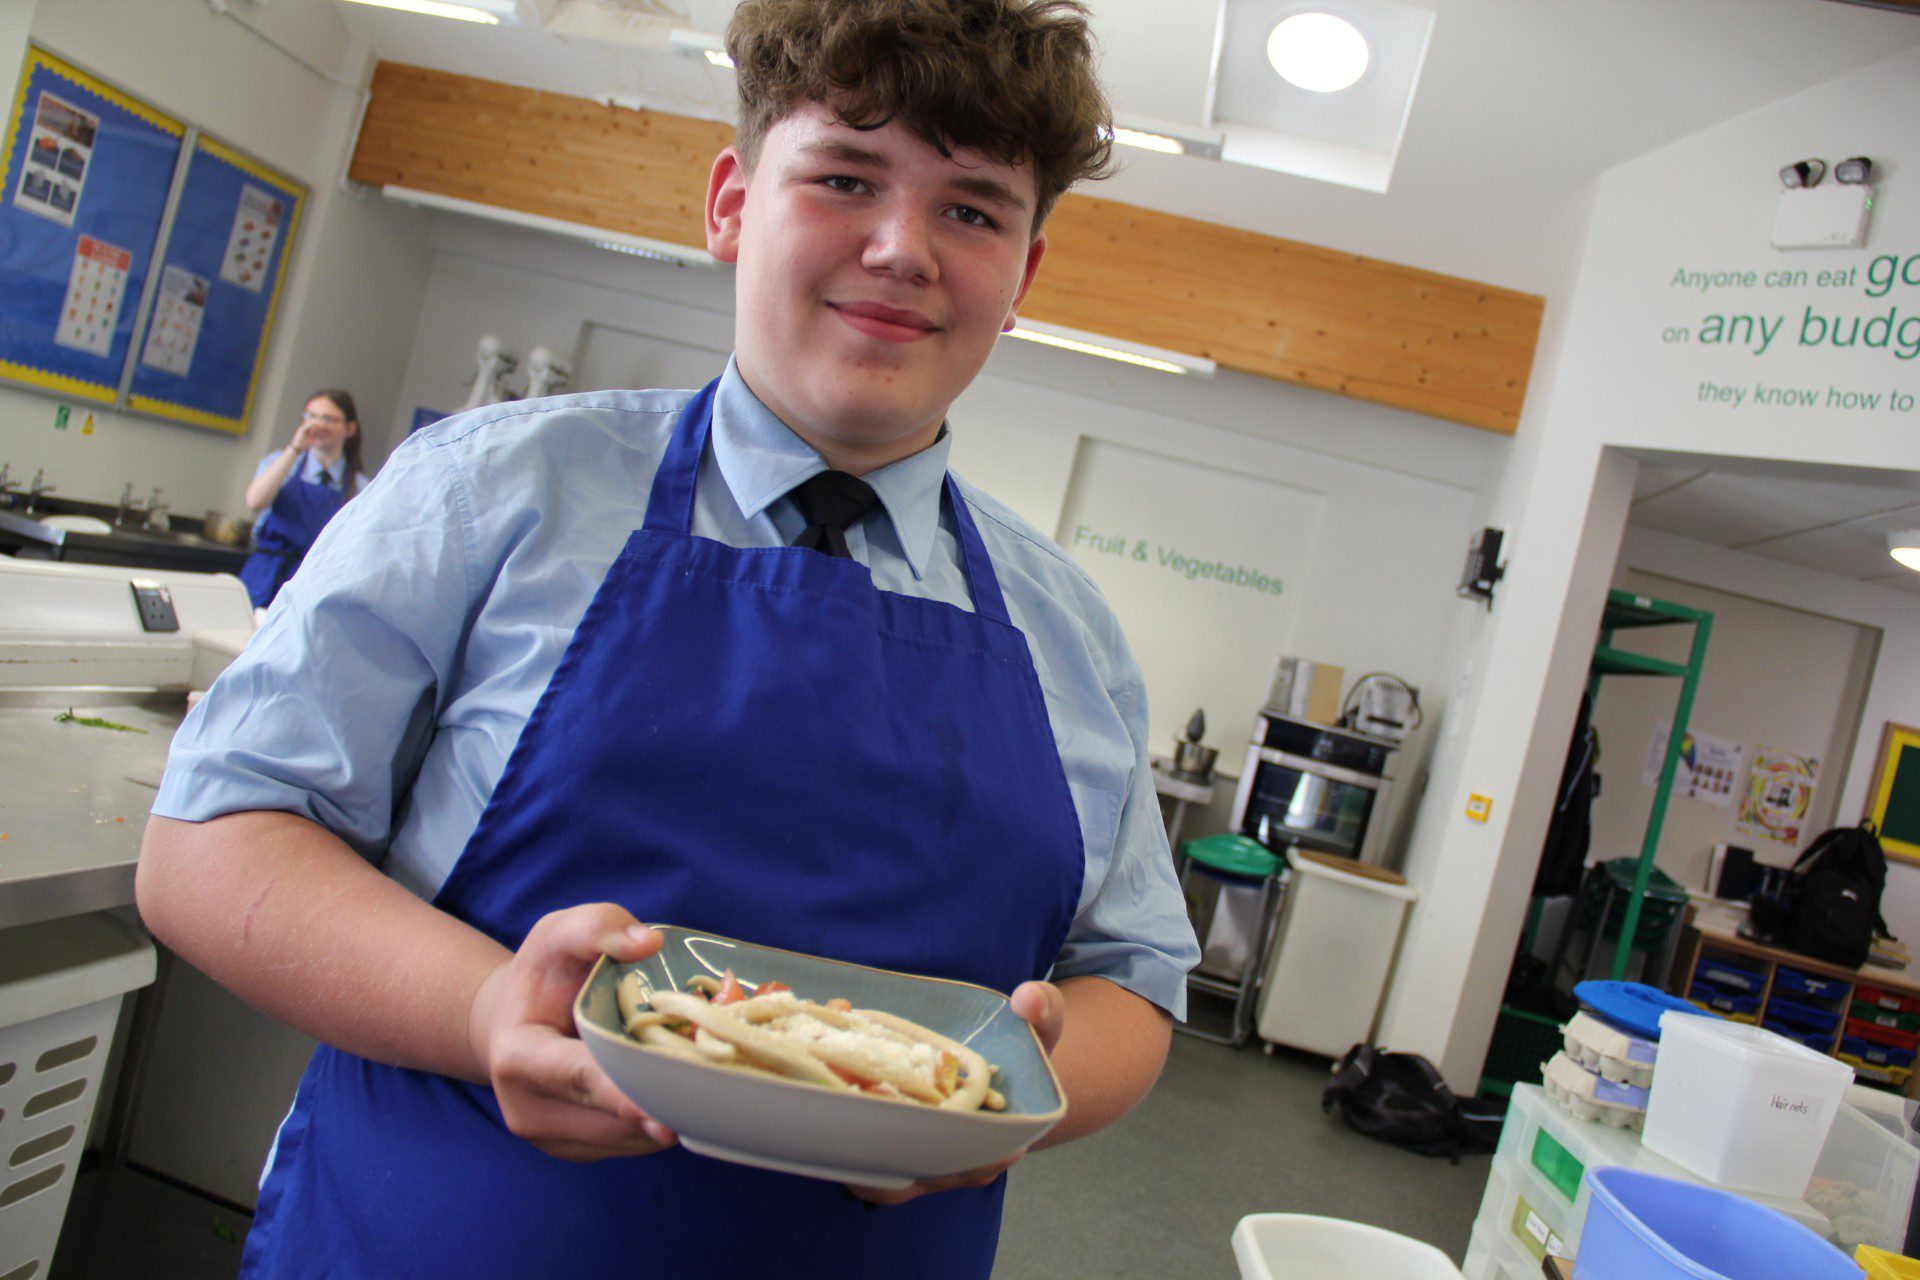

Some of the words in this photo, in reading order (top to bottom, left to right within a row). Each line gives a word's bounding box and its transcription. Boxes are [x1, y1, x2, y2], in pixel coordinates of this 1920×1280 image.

[1670, 267, 1758, 293] Anyone
[1764, 270, 1808, 288] can
[1816, 266, 1858, 288] eat
[1662, 326, 1690, 344] on
[1698, 313, 1784, 356] any
[1799, 304, 1920, 360] budg
[1697, 381, 1748, 409] they
[1754, 383, 1819, 408] know
[1826, 385, 1881, 411] how
[1890, 389, 1915, 412] to
[1074, 525, 1127, 557] Fruit
[1131, 539, 1148, 562] &
[1158, 544, 1284, 596] Vegetables
